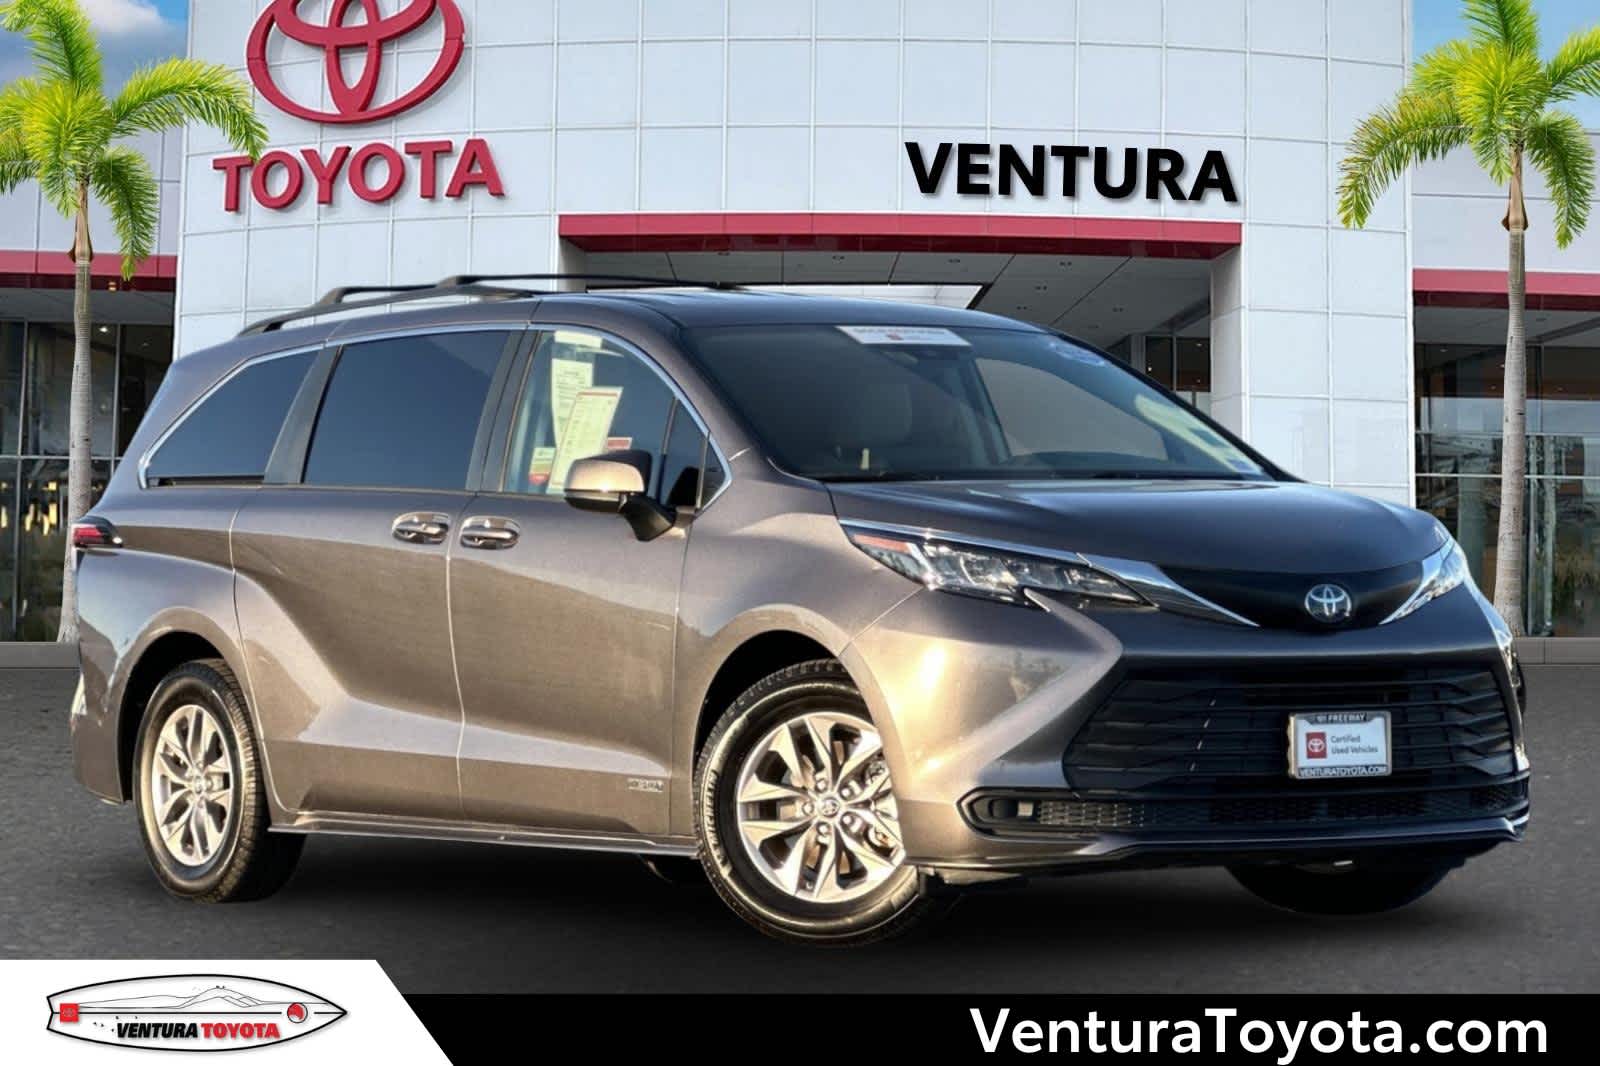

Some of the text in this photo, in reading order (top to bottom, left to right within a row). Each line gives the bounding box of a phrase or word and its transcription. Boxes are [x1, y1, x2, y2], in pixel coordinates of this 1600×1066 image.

[213, 138, 504, 212] TOYOTA
[905, 141, 1239, 203] VENTURA
[1328, 712, 1366, 721] FREEWAY
[1330, 735, 1361, 744] Certified
[1331, 745, 1378, 755] Used Vehicles
